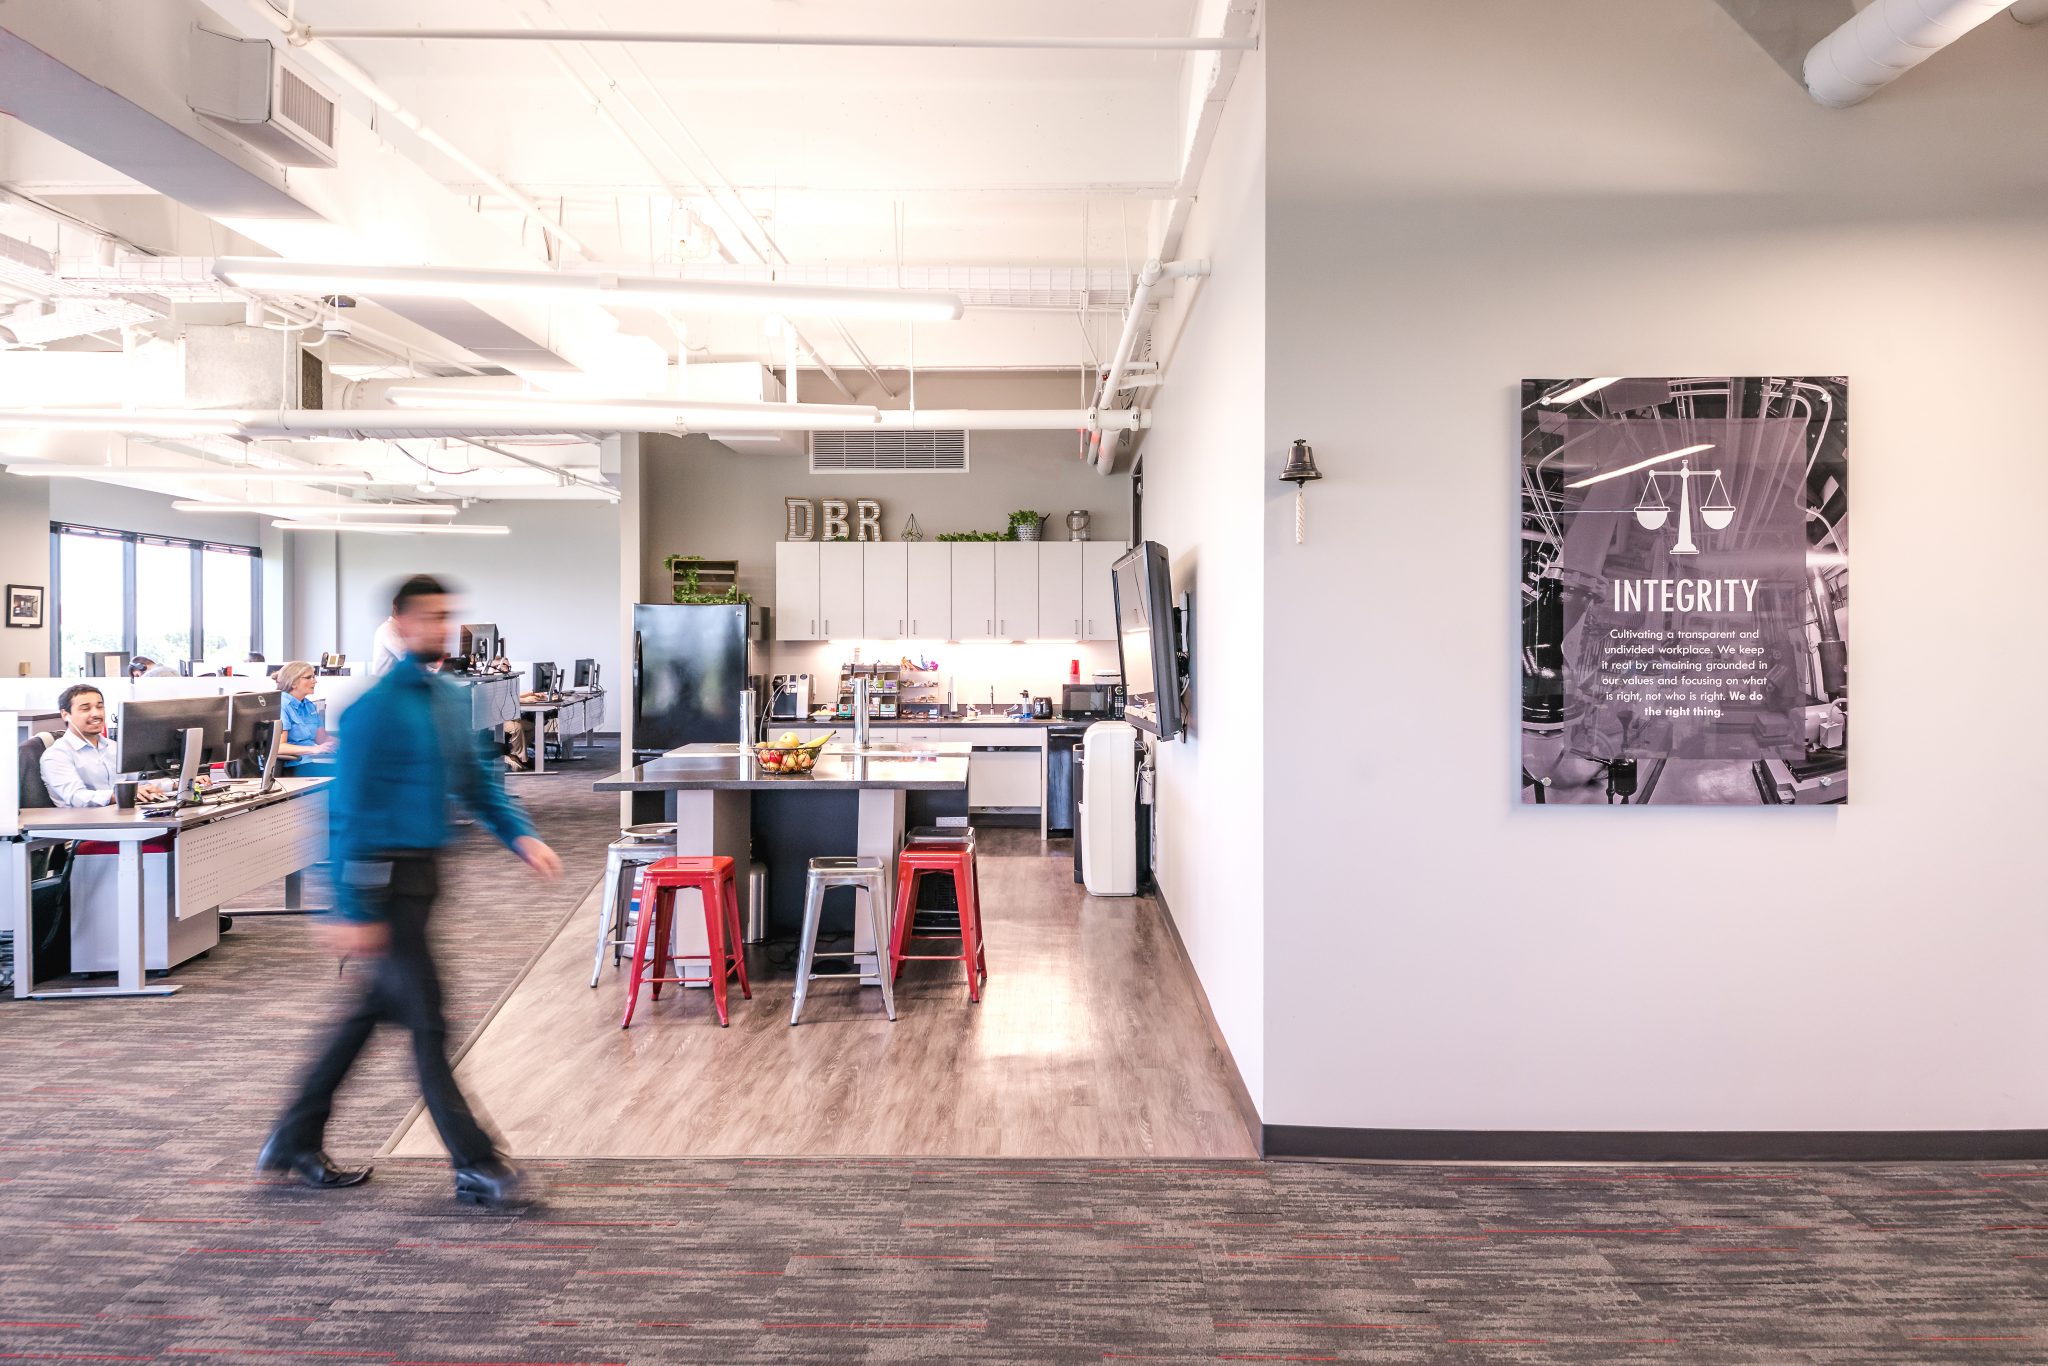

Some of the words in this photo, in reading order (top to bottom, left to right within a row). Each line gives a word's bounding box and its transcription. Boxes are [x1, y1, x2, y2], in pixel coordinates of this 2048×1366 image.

[785, 496, 882, 541] DBR
[1614, 579, 1758, 612] INTEGRITY
[1610, 629, 1662, 641] Cultivating
[1667, 631, 1673, 639] a
[1678, 630, 1735, 641] transparent
[1740, 629, 1759, 639] and
[1604, 644, 1654, 655] undivided
[1658, 644, 1713, 656] workplace.
[1717, 645, 1735, 655] We
[1740, 644, 1764, 656] keep
[1602, 660, 1608, 670] it
[1611, 660, 1632, 670] real
[1635, 660, 1648, 672] by
[1653, 660, 1701, 672] remaining
[1706, 660, 1755, 672] grounded
[1759, 660, 1767, 670] in
[1602, 677, 1619, 685] our
[1623, 675, 1654, 685] values
[1658, 675, 1677, 685] and
[1681, 675, 1722, 687] focusing
[1726, 677, 1739, 685] on
[1742, 675, 1767, 685] what
[1606, 691, 1613, 700] is
[1617, 691, 1642, 702] right,
[1645, 692, 1661, 700] not
[1665, 691, 1685, 701] who
[1690, 691, 1696, 700] is
[1701, 691, 1725, 702] right.
[1729, 691, 1746, 700] We
[1749, 691, 1763, 700] do
[1645, 706, 1661, 716] the
[1665, 706, 1690, 718] right
[1692, 706, 1724, 718] thing.
